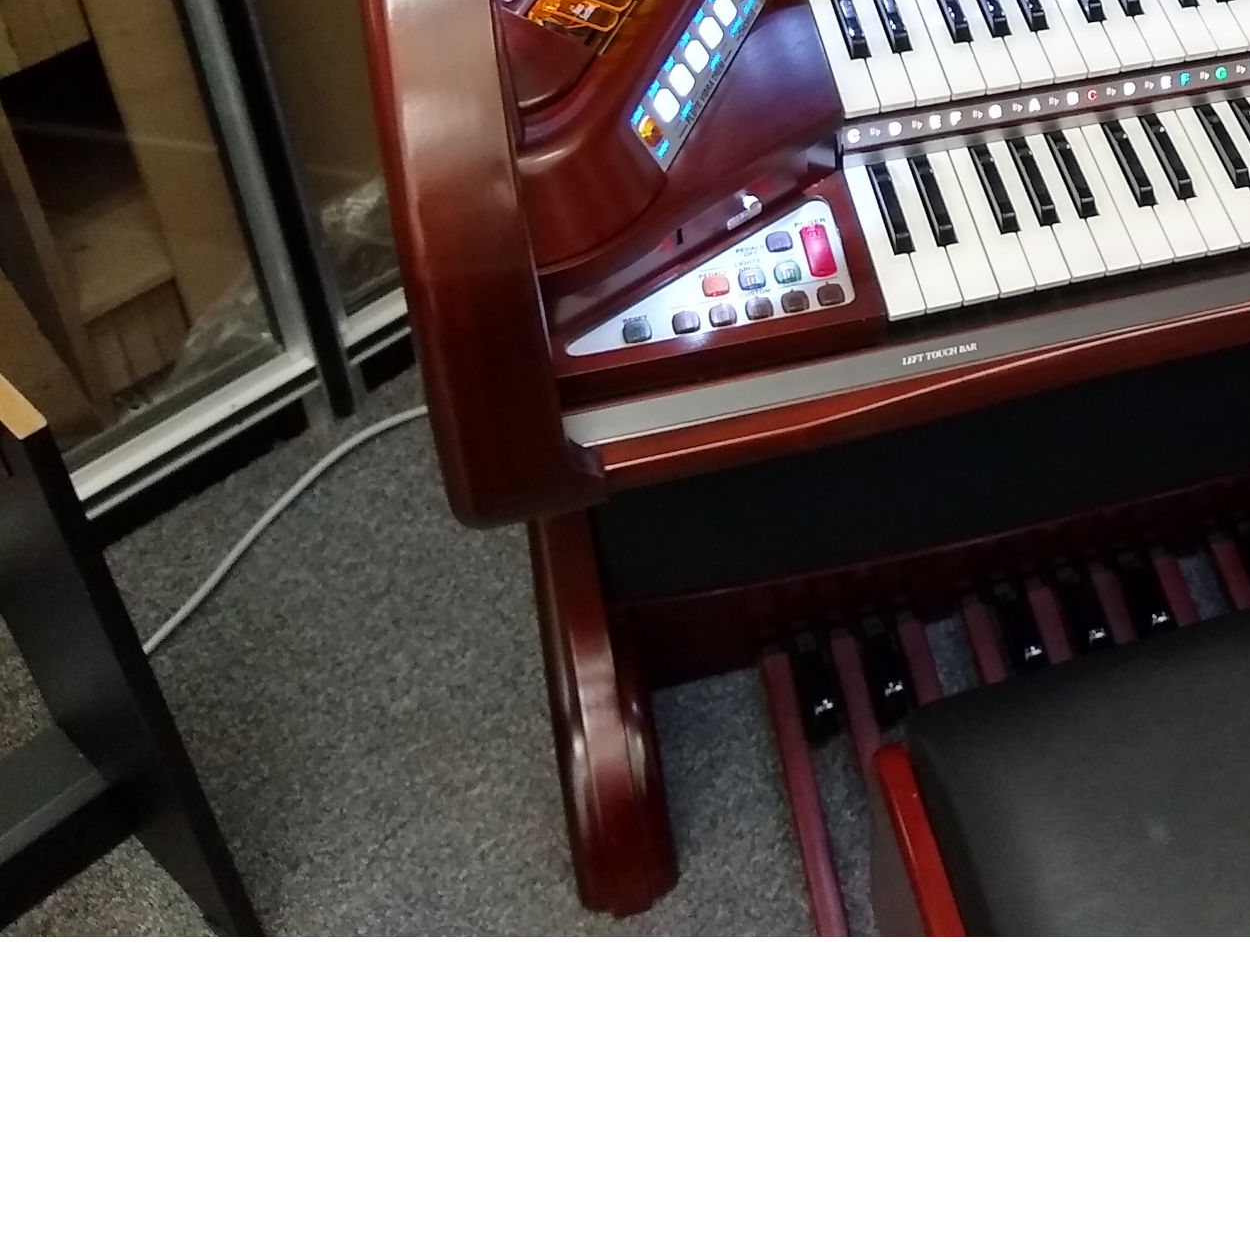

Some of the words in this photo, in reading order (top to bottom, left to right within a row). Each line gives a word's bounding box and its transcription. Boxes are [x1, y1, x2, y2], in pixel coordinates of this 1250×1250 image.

[846, 128, 861, 144] C
[949, 111, 962, 126] F
[1028, 97, 1041, 113] A
[1087, 89, 1098, 101] C
[1179, 72, 1191, 87] F
[622, 314, 648, 323] RESET
[902, 354, 924, 366] LEFT
[926, 346, 958, 360] TOUCH
[958, 342, 978, 353] BAR
